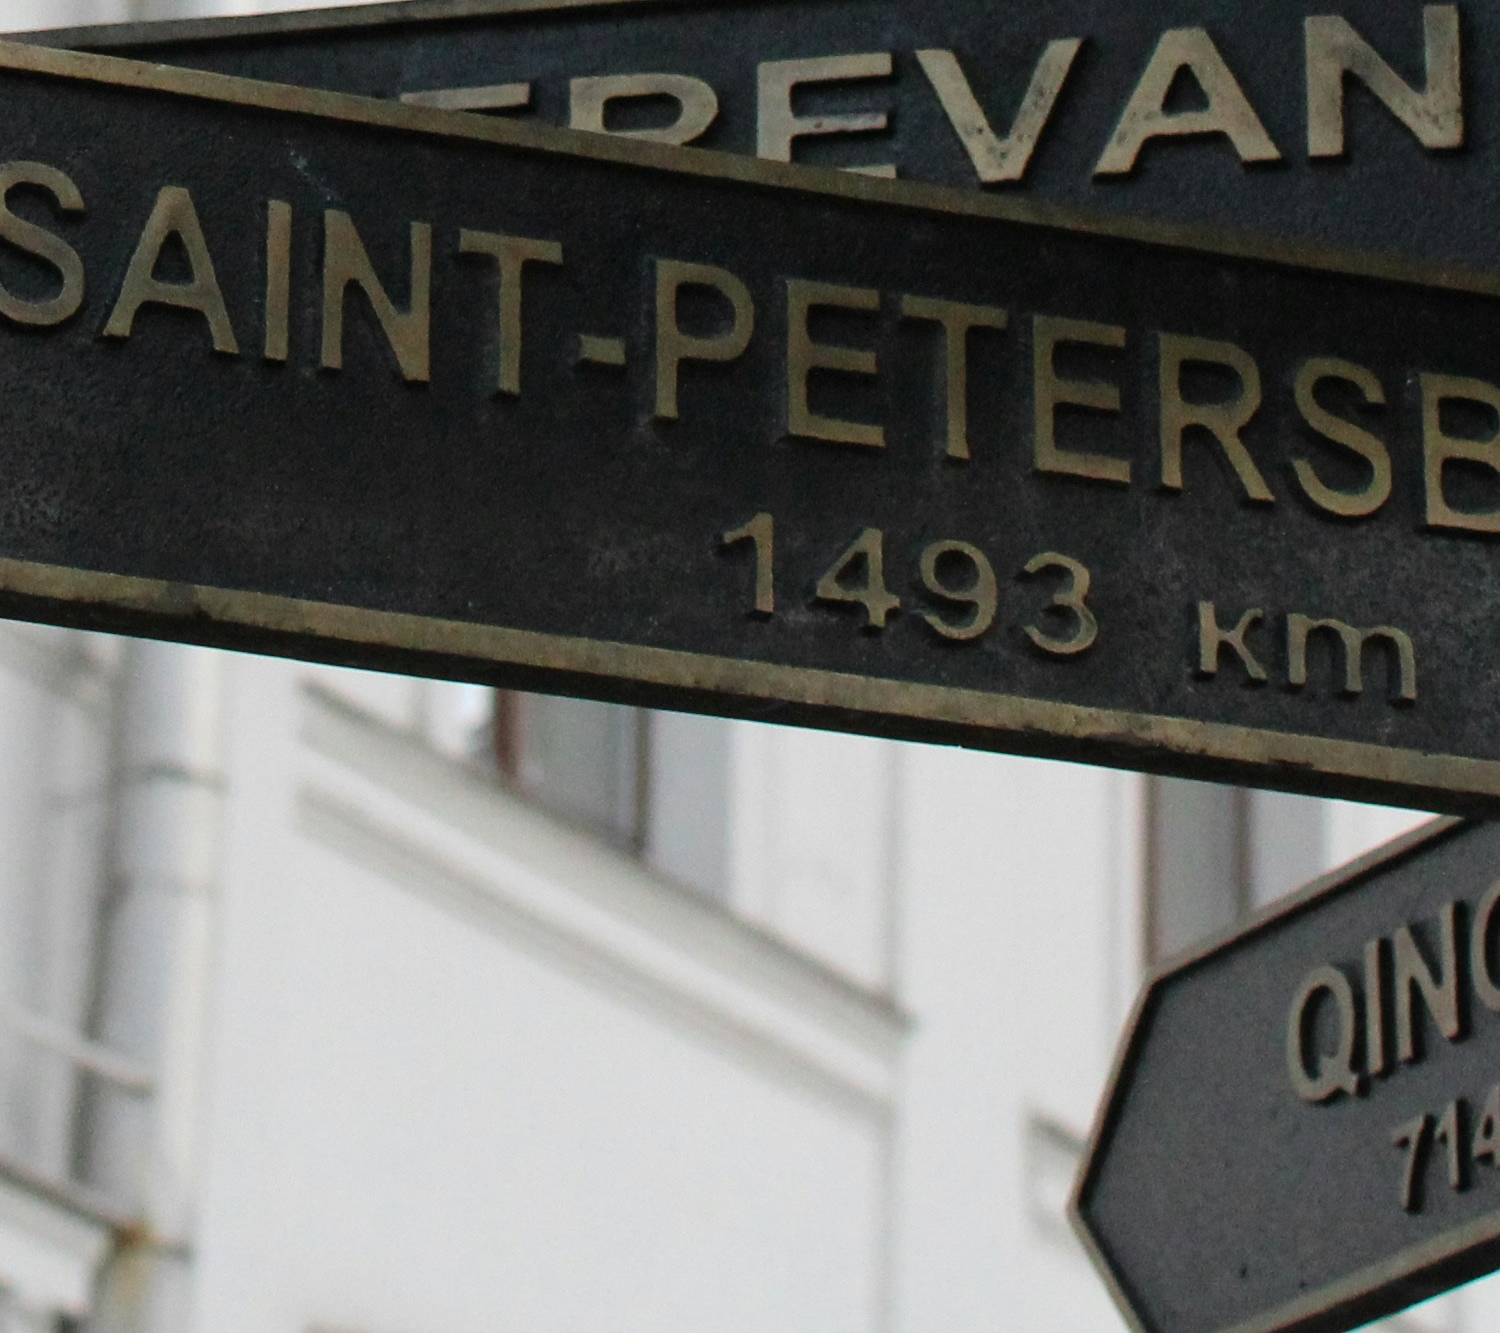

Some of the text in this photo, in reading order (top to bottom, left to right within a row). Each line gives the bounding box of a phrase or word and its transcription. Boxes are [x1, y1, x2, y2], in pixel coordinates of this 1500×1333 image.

[399, 4, 1464, 183] REVAN
[722, 514, 1416, 700] 1493 km
